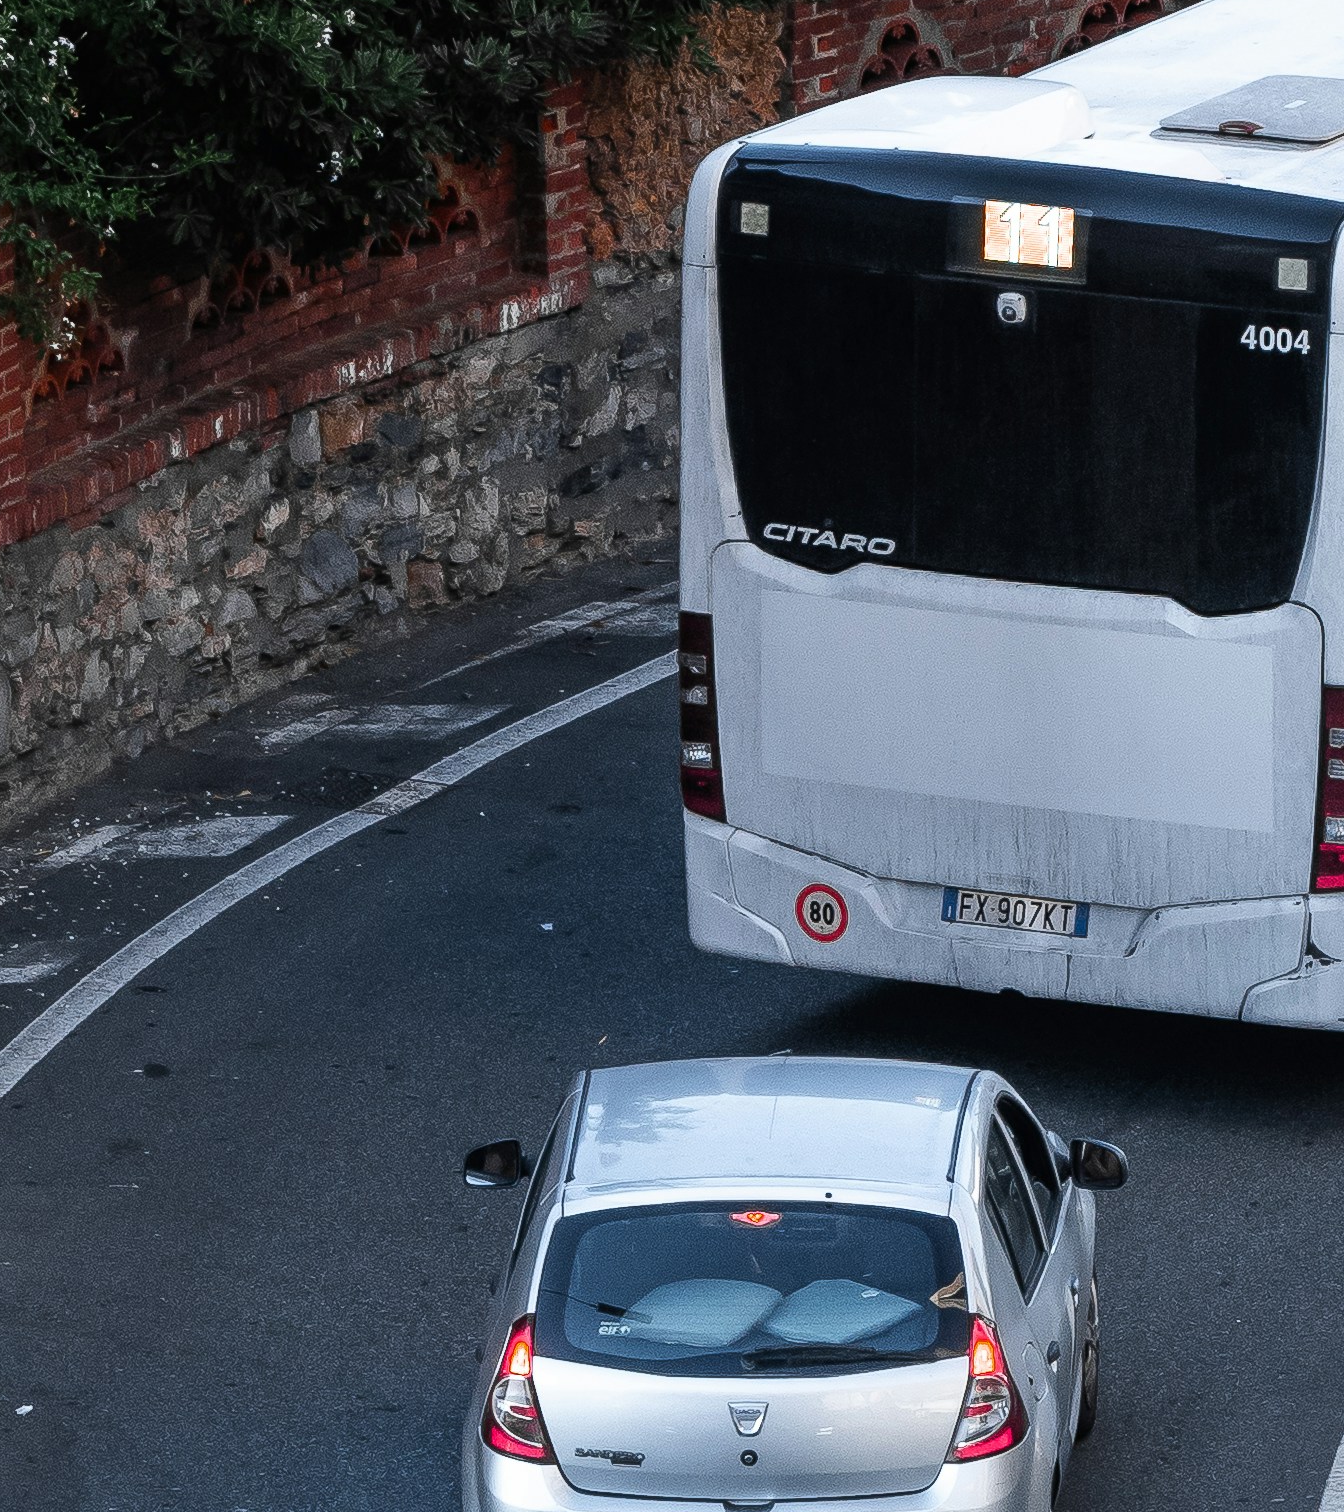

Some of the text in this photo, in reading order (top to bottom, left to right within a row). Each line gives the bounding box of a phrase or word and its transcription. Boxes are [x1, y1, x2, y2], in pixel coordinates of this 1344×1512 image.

[999, 202, 1060, 267] 11
[1240, 323, 1312, 356] 4004
[763, 522, 897, 556] CITARO
[809, 900, 835, 926] 80
